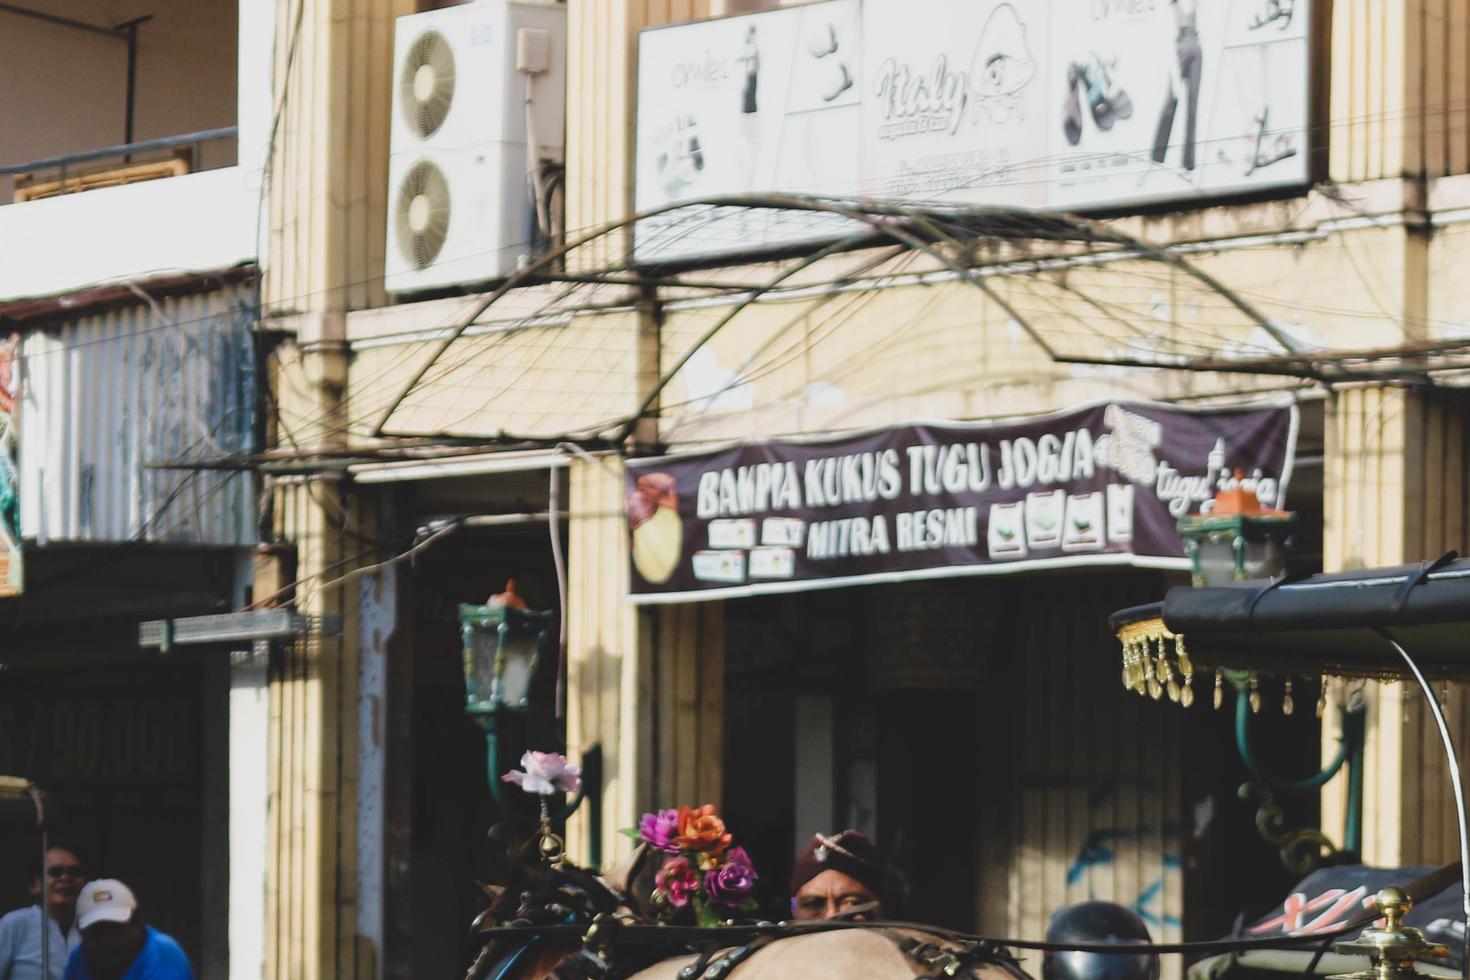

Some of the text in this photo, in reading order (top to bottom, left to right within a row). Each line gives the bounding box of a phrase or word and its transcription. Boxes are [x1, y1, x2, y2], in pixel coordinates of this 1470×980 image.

[697, 461, 801, 519] BAKPIA
[804, 448, 903, 508] KUKUS
[906, 442, 991, 495] TUGU
[997, 427, 1095, 490] JOGJA
[1156, 459, 1212, 519] tugu
[807, 506, 978, 560] MITRA RESMI
